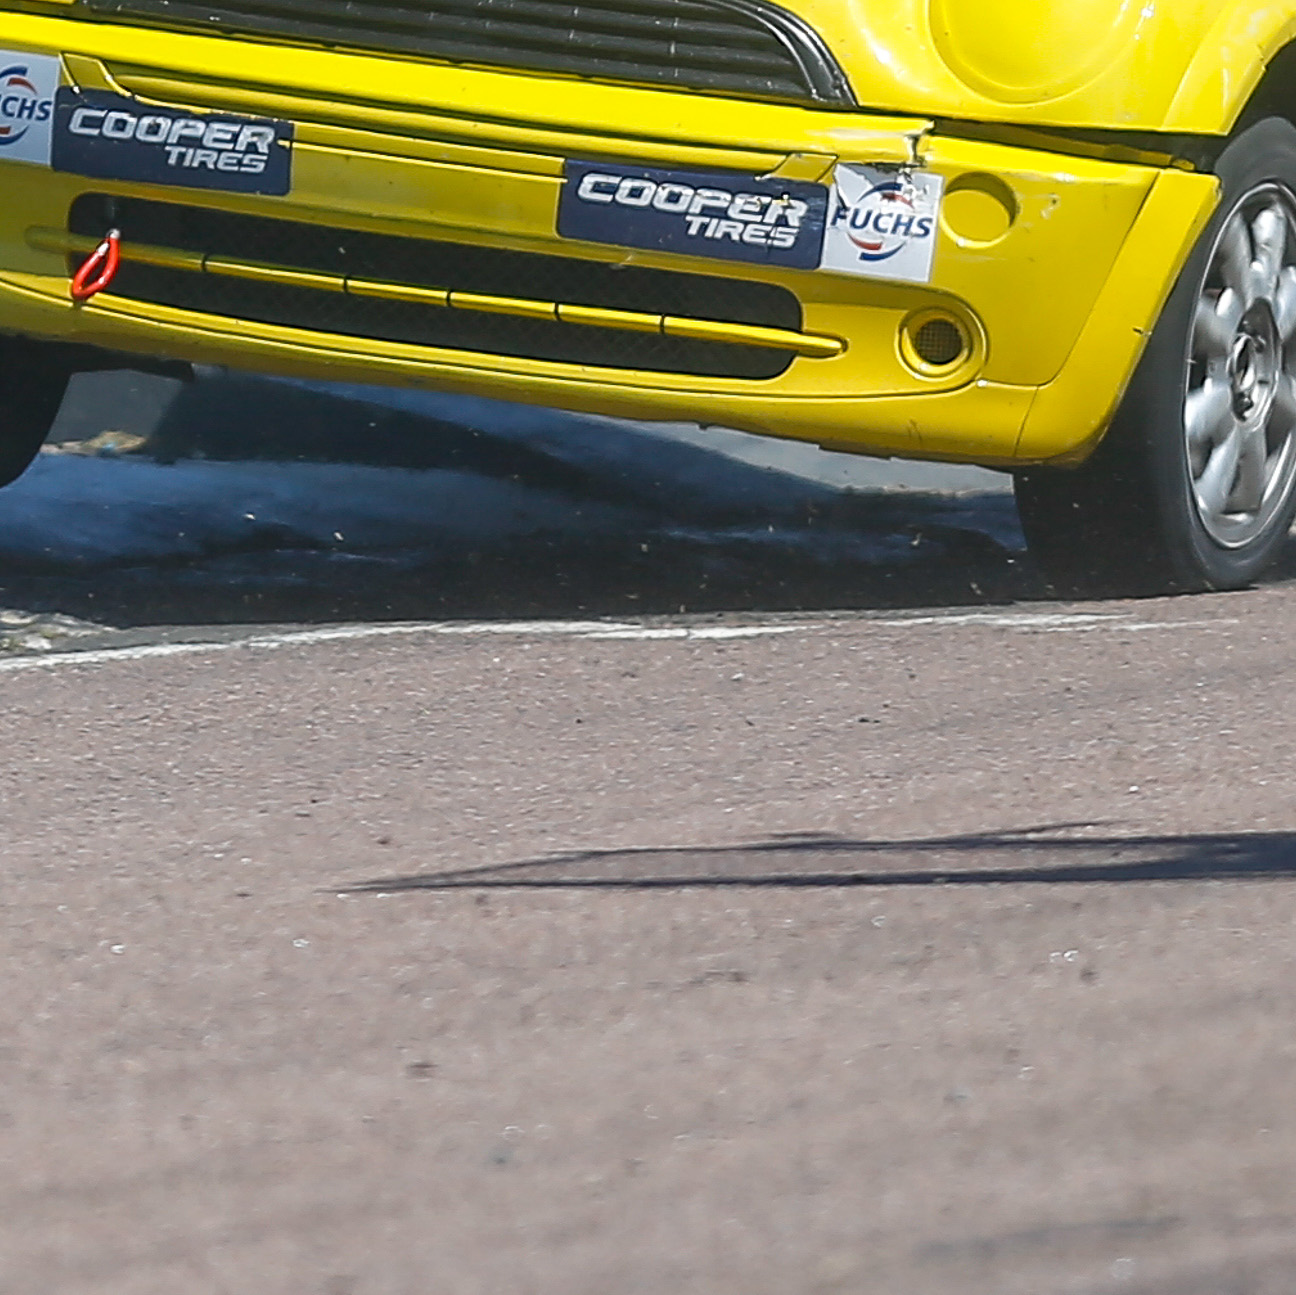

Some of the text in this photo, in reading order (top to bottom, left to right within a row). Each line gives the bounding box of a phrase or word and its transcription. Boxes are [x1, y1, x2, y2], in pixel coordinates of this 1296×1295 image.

[68, 106, 275, 154] COOPER
[164, 145, 267, 173] TIRES
[577, 173, 808, 227] COOPER
[684, 214, 799, 249] TIRES
[830, 206, 934, 239] FUCHS
